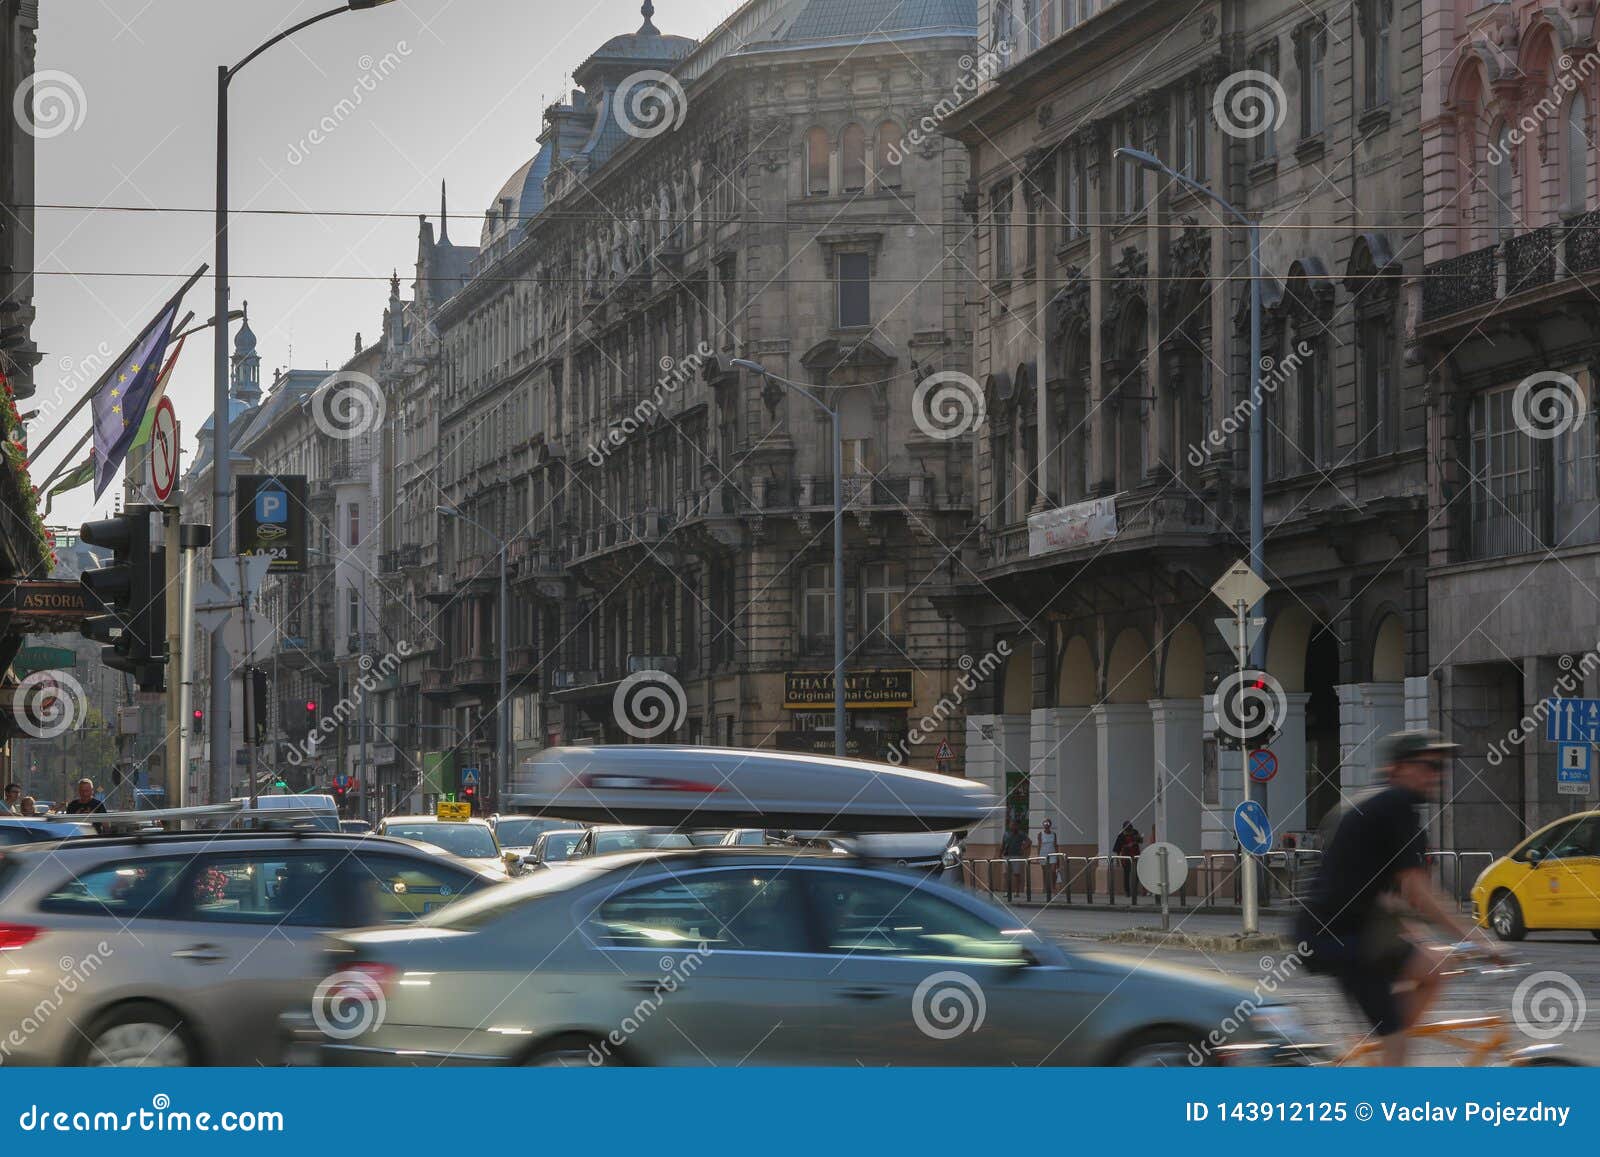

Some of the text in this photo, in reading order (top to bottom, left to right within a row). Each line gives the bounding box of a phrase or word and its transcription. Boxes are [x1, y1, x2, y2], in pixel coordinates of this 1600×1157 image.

[23, 594, 84, 608] ASTORIA
[789, 678, 827, 690] THAI
[788, 691, 834, 702] Original
[864, 690, 908, 700] Cuisine
